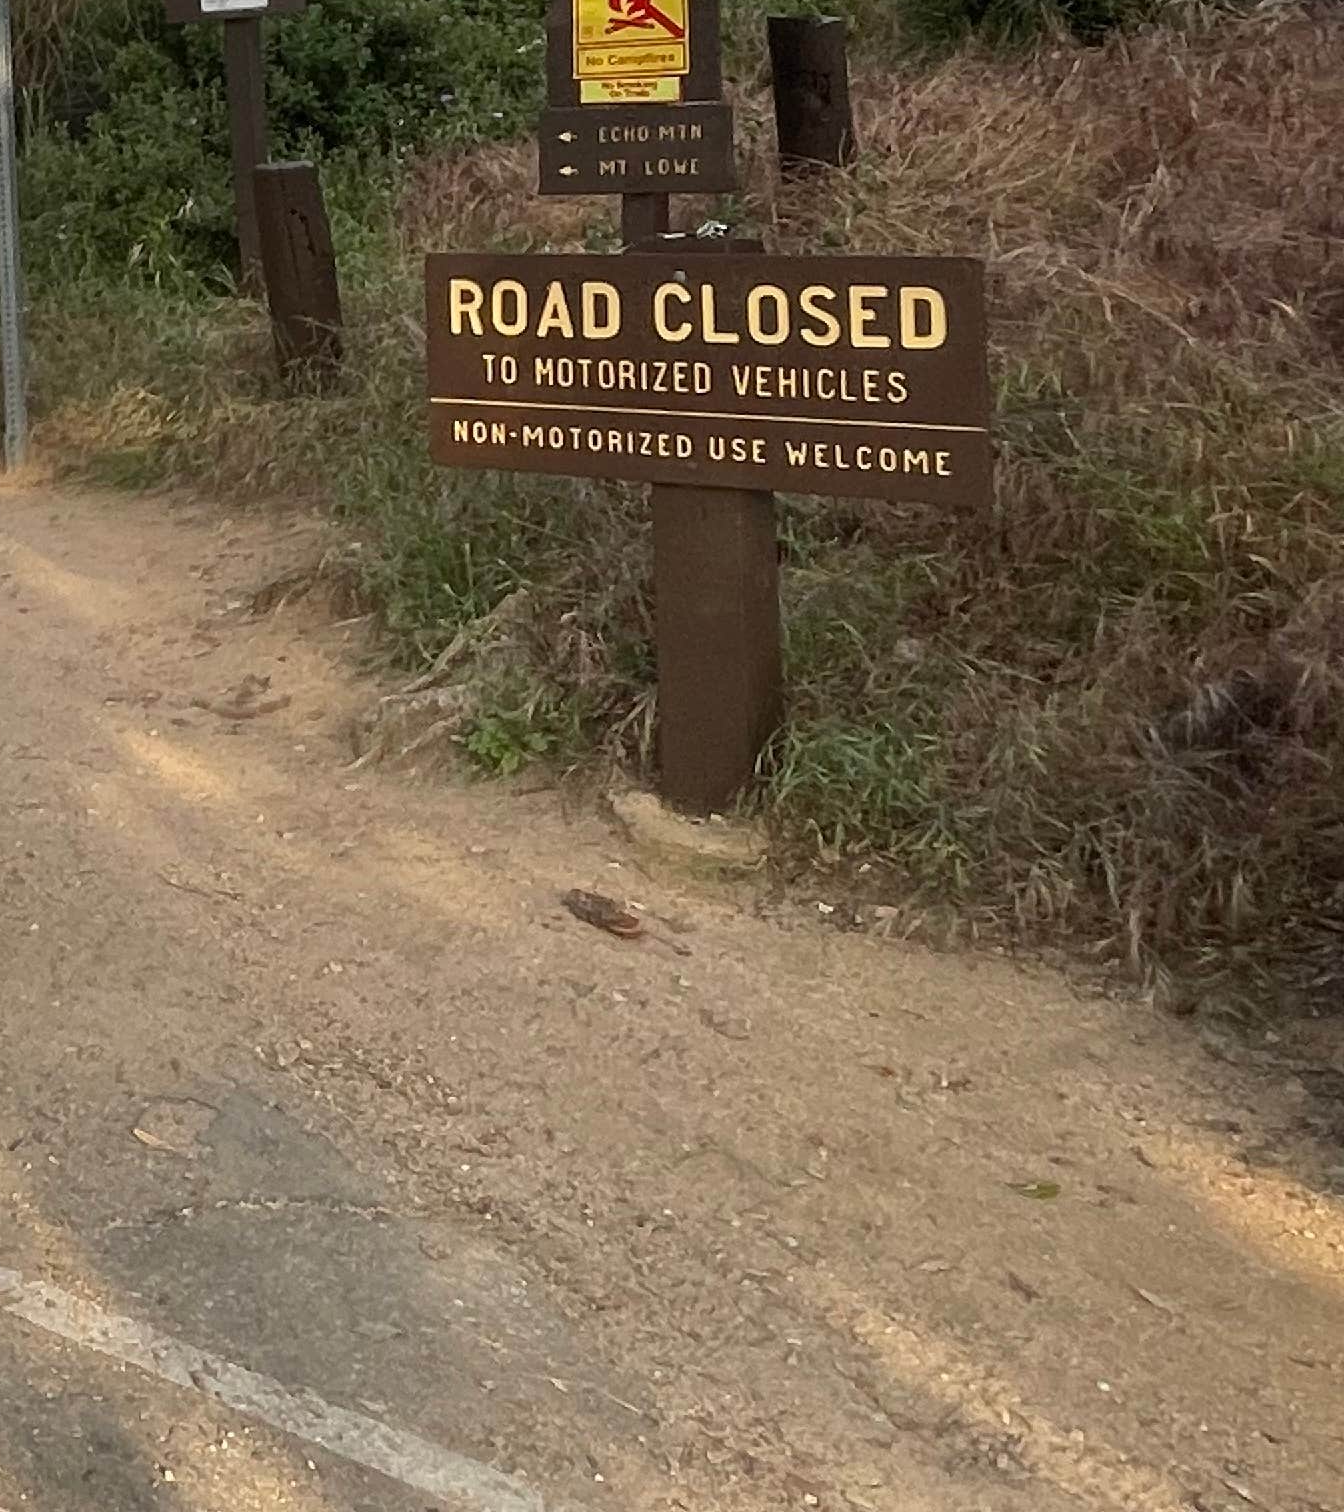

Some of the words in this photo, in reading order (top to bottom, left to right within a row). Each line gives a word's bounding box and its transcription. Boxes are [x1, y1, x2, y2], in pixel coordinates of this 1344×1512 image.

[585, 55, 604, 67] No
[608, 52, 675, 66] Campfires
[598, 125, 650, 144] ECHO
[658, 123, 703, 141] MTN
[598, 158, 627, 177] MT
[644, 157, 700, 177] LOWE
[449, 277, 622, 340] ROAD
[653, 281, 949, 350] CLOSED
[482, 353, 518, 385] TO
[534, 356, 712, 395] MOTORIZED
[731, 364, 909, 404] VEHICLES
[453, 419, 693, 459] NON-MOTORIZED
[708, 436, 767, 464] USE
[785, 441, 954, 477] WELCOME
